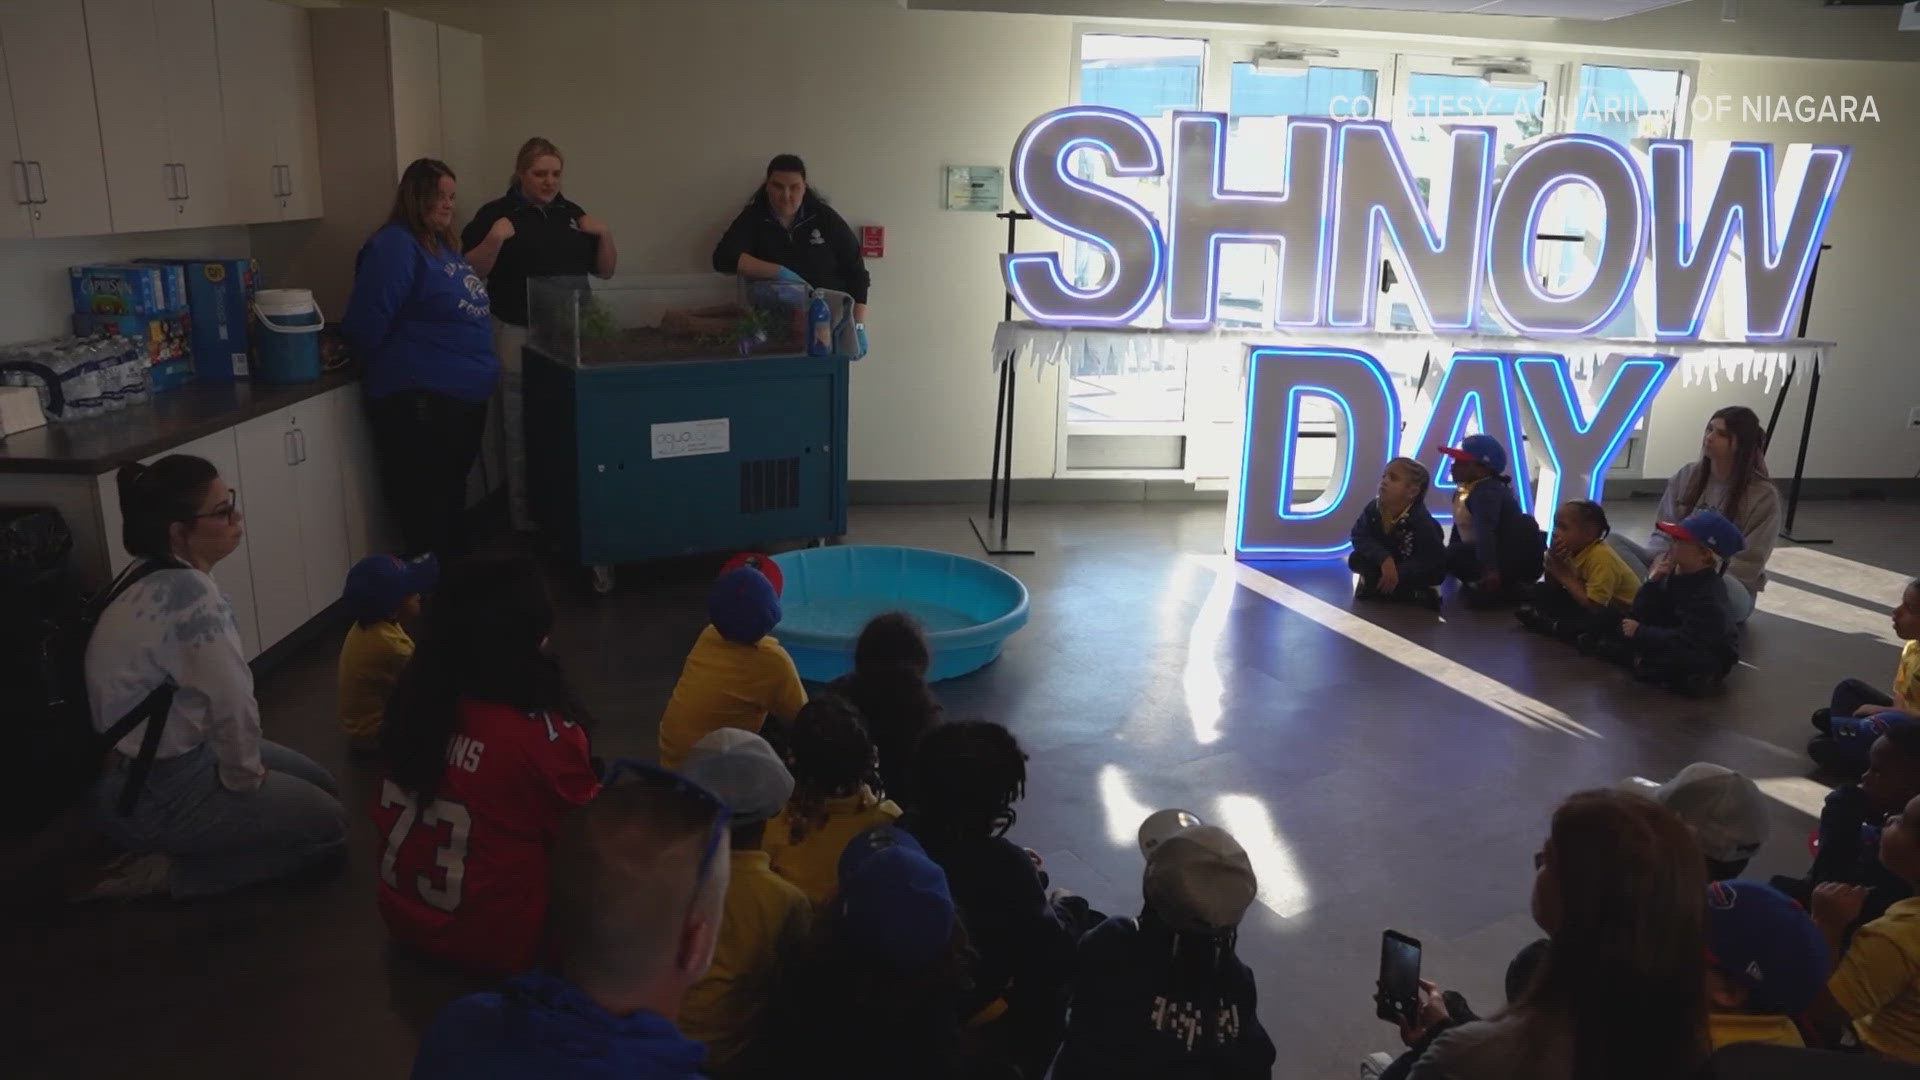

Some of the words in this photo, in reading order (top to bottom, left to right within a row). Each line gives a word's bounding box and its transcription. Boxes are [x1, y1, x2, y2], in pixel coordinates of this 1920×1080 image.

[1000, 105, 1853, 341] SHNOW
[1235, 345, 1677, 562] DAY
[380, 779, 472, 913] 73
